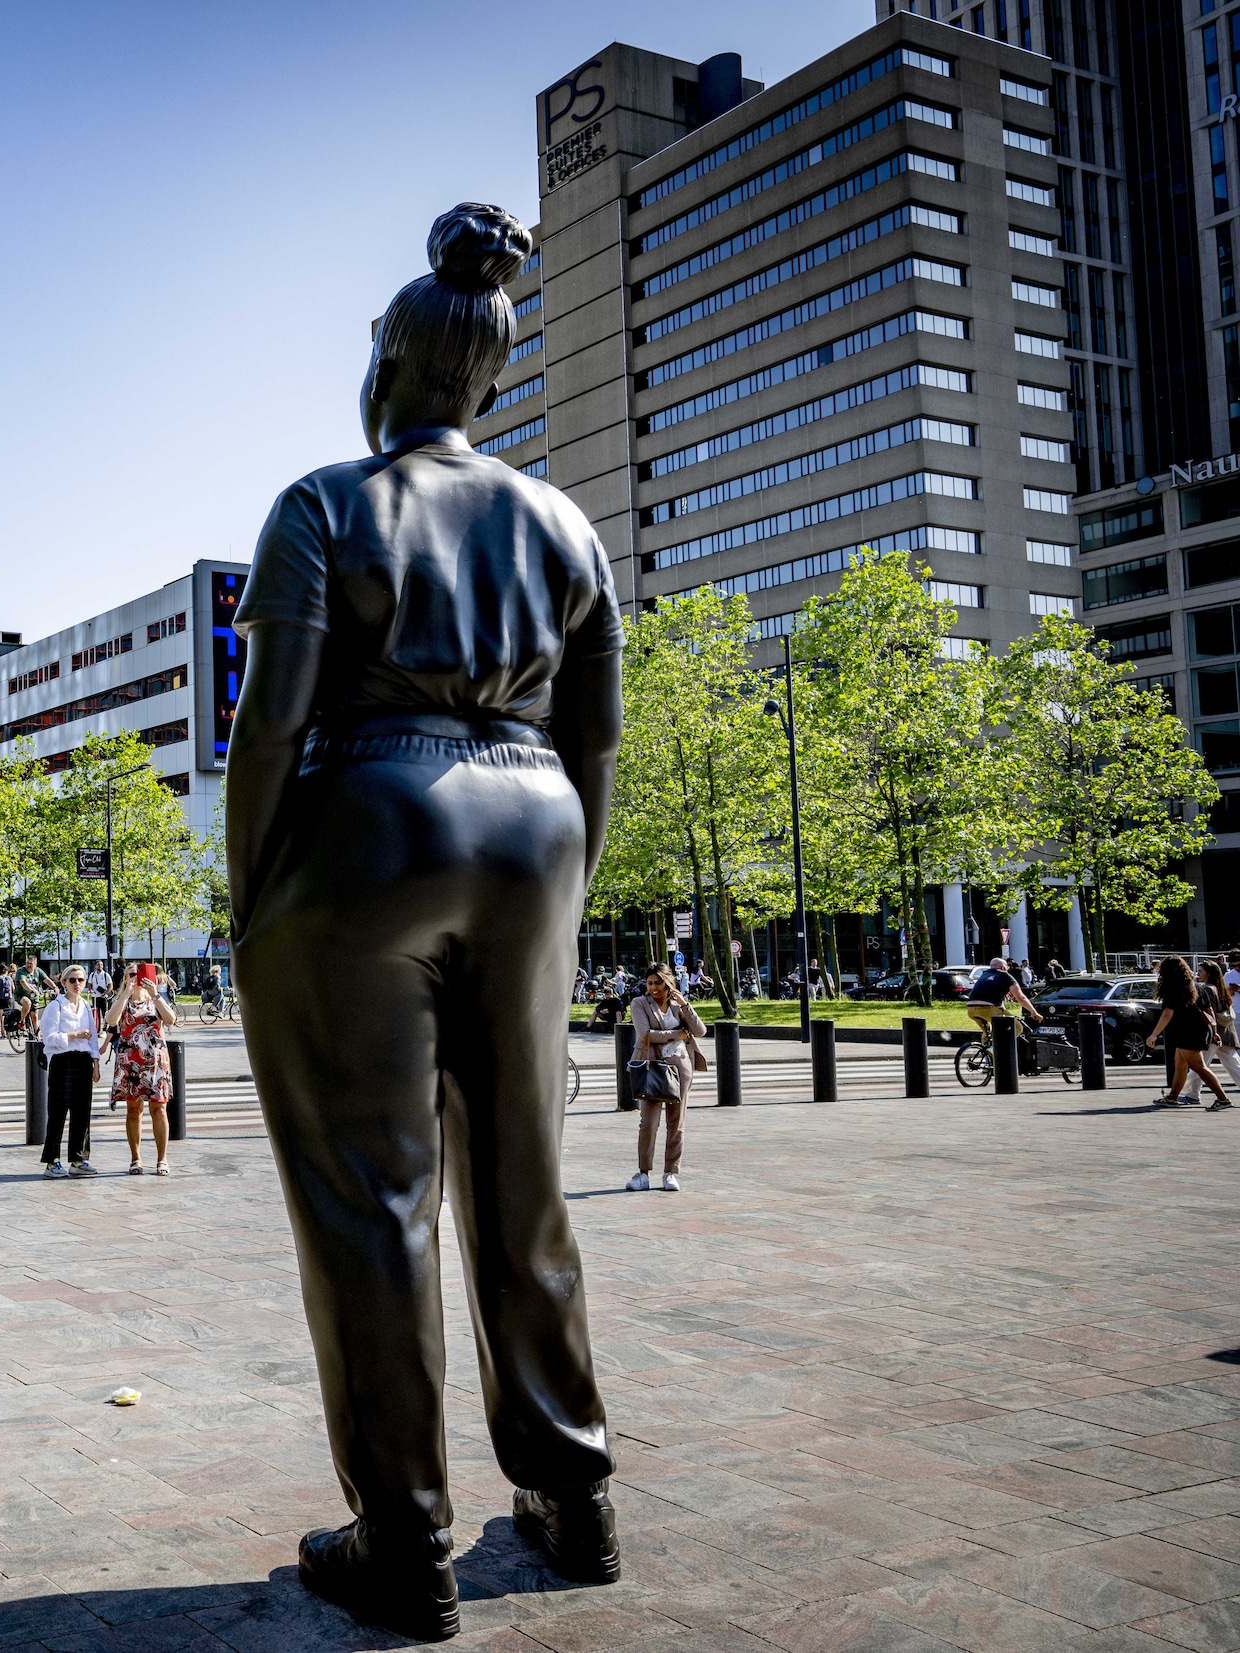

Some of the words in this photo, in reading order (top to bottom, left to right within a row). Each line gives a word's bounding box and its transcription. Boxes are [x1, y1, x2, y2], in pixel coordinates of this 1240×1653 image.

[544, 60, 605, 146] PS
[1219, 93, 1240, 124] R
[547, 122, 602, 164] PREMIER
[547, 141, 593, 176] SUITES
[558, 144, 607, 181] OFFICES
[866, 935, 880, 949] PS
